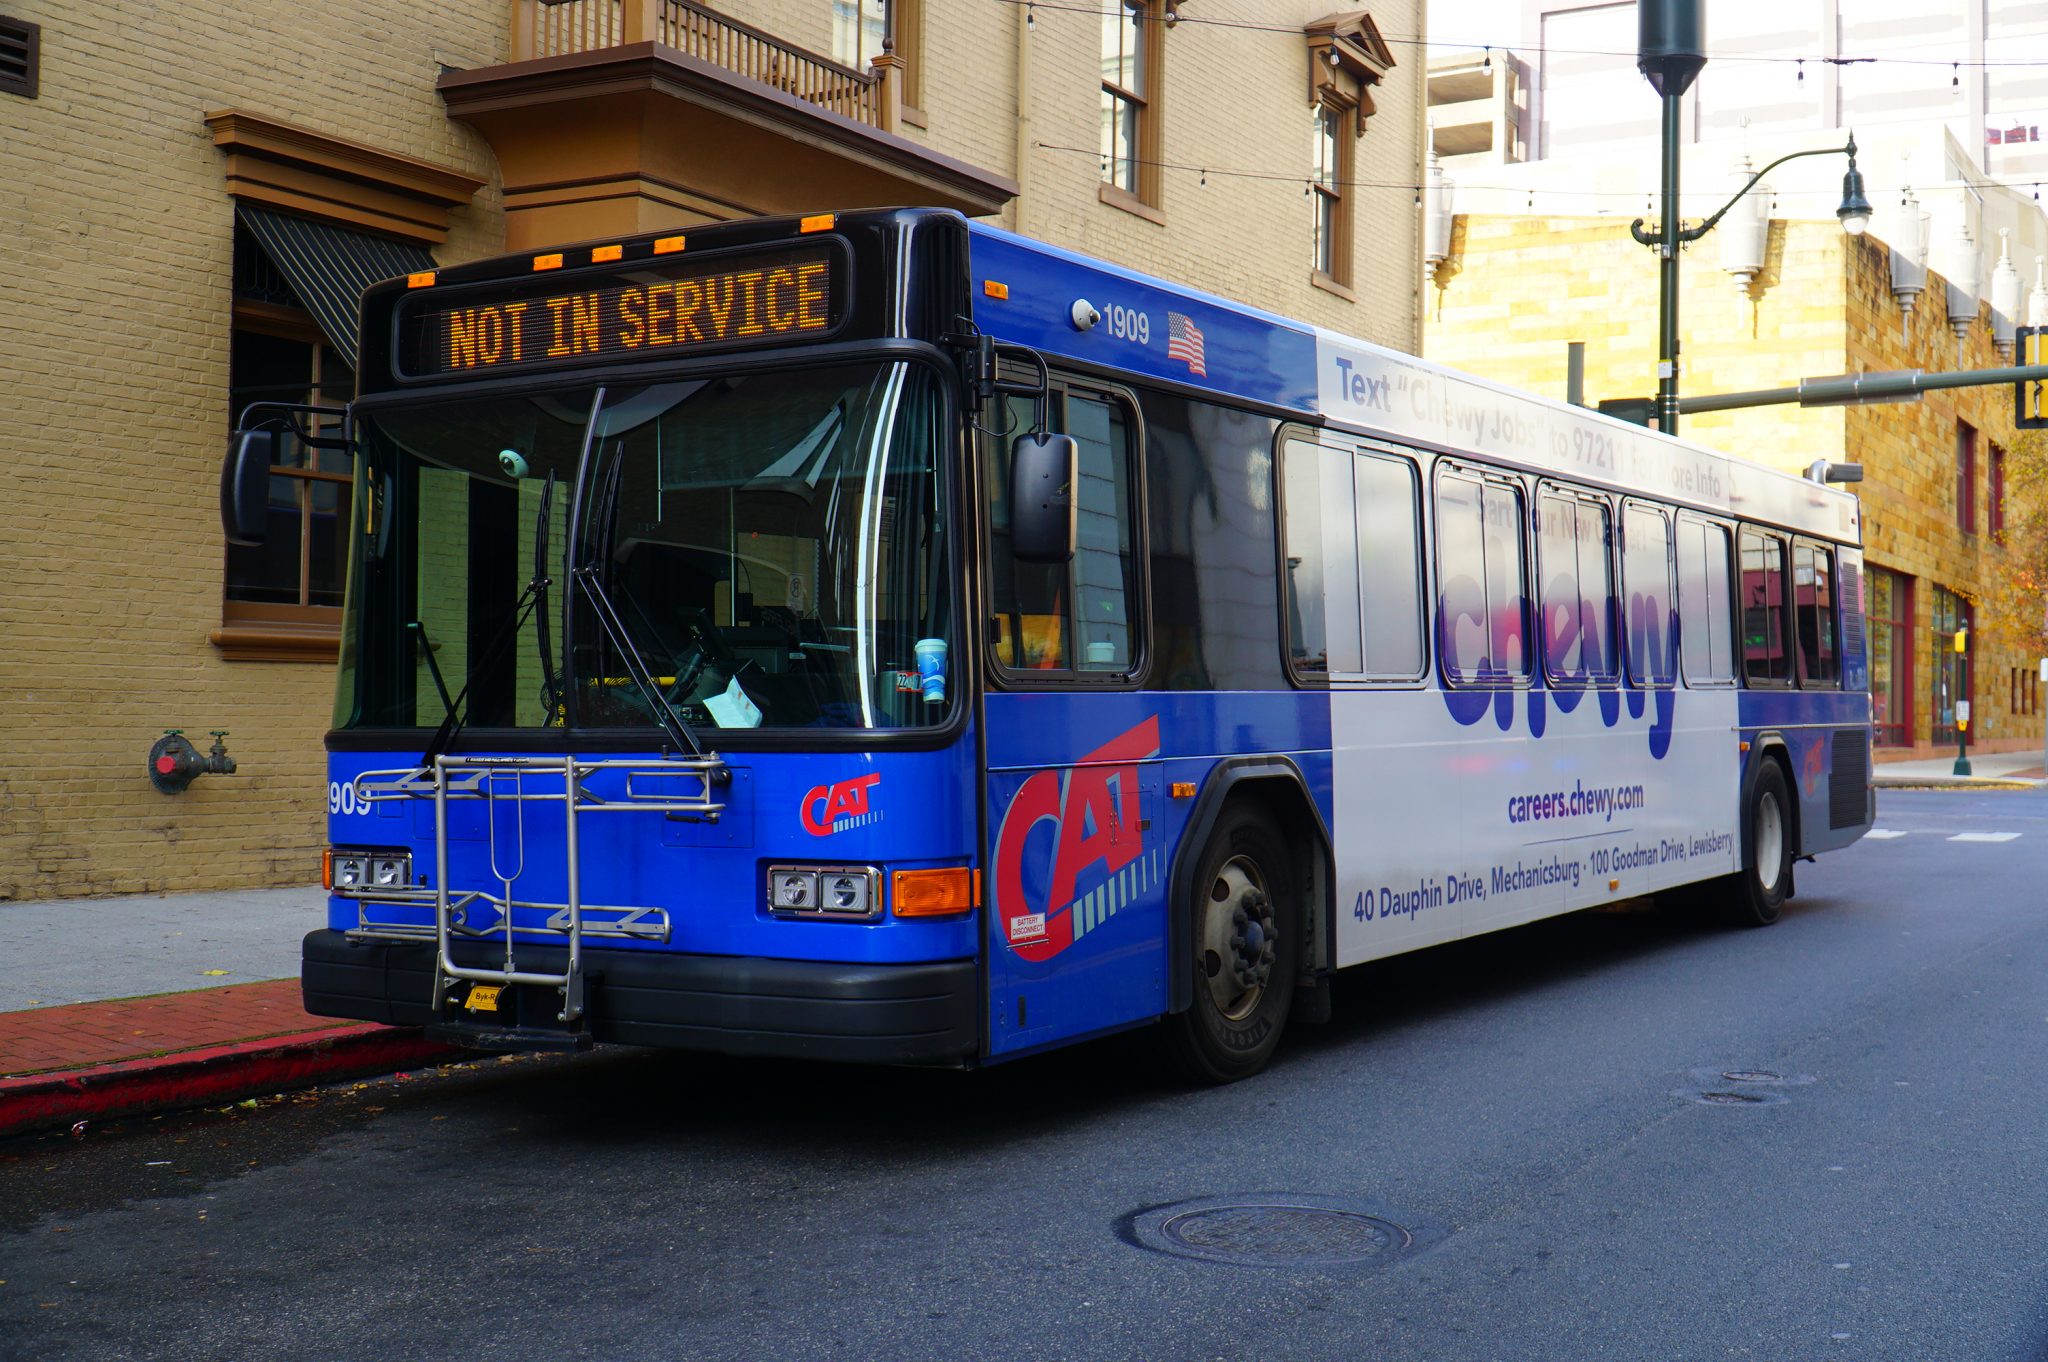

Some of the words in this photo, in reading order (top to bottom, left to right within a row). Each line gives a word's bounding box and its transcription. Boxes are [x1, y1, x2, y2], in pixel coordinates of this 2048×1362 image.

[451, 302, 528, 368] NOT
[546, 293, 599, 356] IN
[618, 264, 826, 348] SERVICE
[1104, 302, 1149, 345] 1909
[1336, 356, 1392, 413] Text
[1551, 425, 1569, 458] to
[1695, 461, 1721, 499] Info
[1433, 535, 1682, 760] chewy
[327, 781, 372, 816] 909
[800, 771, 881, 837] CAT
[1508, 778, 1645, 824] careers.chewy.com
[993, 713, 1161, 963] CAT
[1354, 889, 1375, 923] 40
[1380, 878, 1442, 921] Dauphin
[1447, 871, 1487, 905] Drive,
[1491, 855, 1580, 895] Mechanicsburg
[1590, 850, 1609, 876] 100
[1612, 842, 1659, 872] Goodman
[1661, 836, 1687, 864] Drive,
[1689, 829, 1734, 857] Lewisberry
[1012, 924, 1044, 936] DISCONNECT
[1017, 916, 1039, 926] BATTERY
